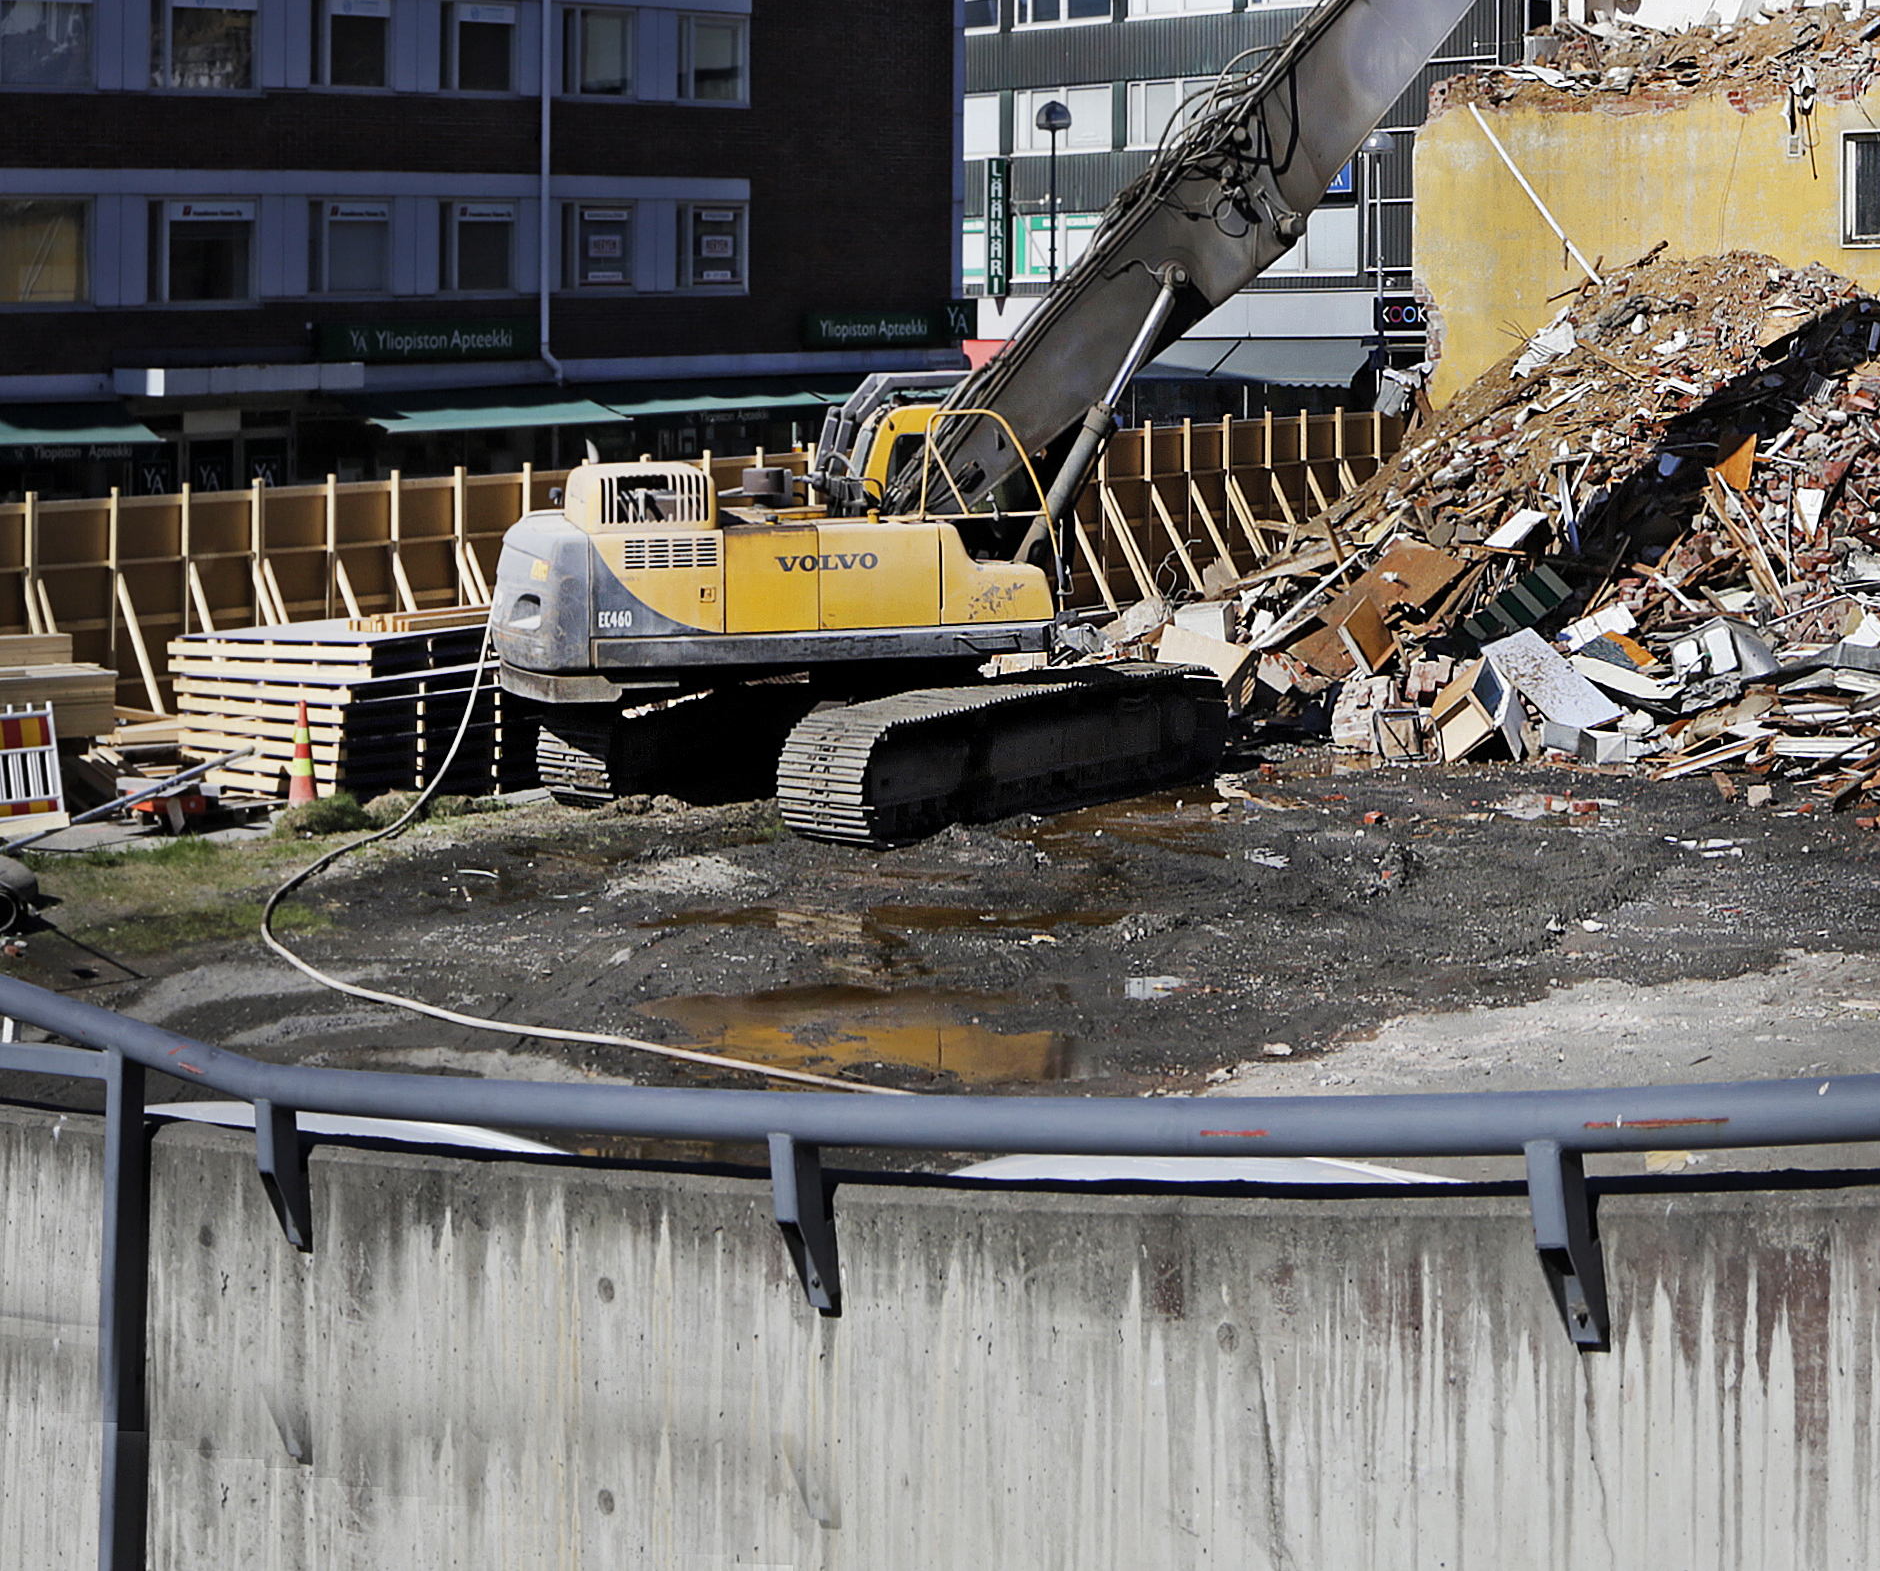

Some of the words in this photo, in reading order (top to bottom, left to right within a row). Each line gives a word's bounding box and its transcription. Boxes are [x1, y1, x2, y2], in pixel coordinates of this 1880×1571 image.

[990, 160, 1004, 294] LÄÄKÄRI
[820, 319, 877, 342] Yliopiston
[878, 318, 928, 342] Apteekki
[947, 306, 969, 335] YA
[376, 330, 448, 355] Yliopiston
[451, 329, 513, 353] Apteekki
[33, 444, 82, 461] Yliopiston
[88, 443, 133, 460] Apteekki
[775, 551, 878, 572] VOLVO
[598, 609, 633, 629] EC460
